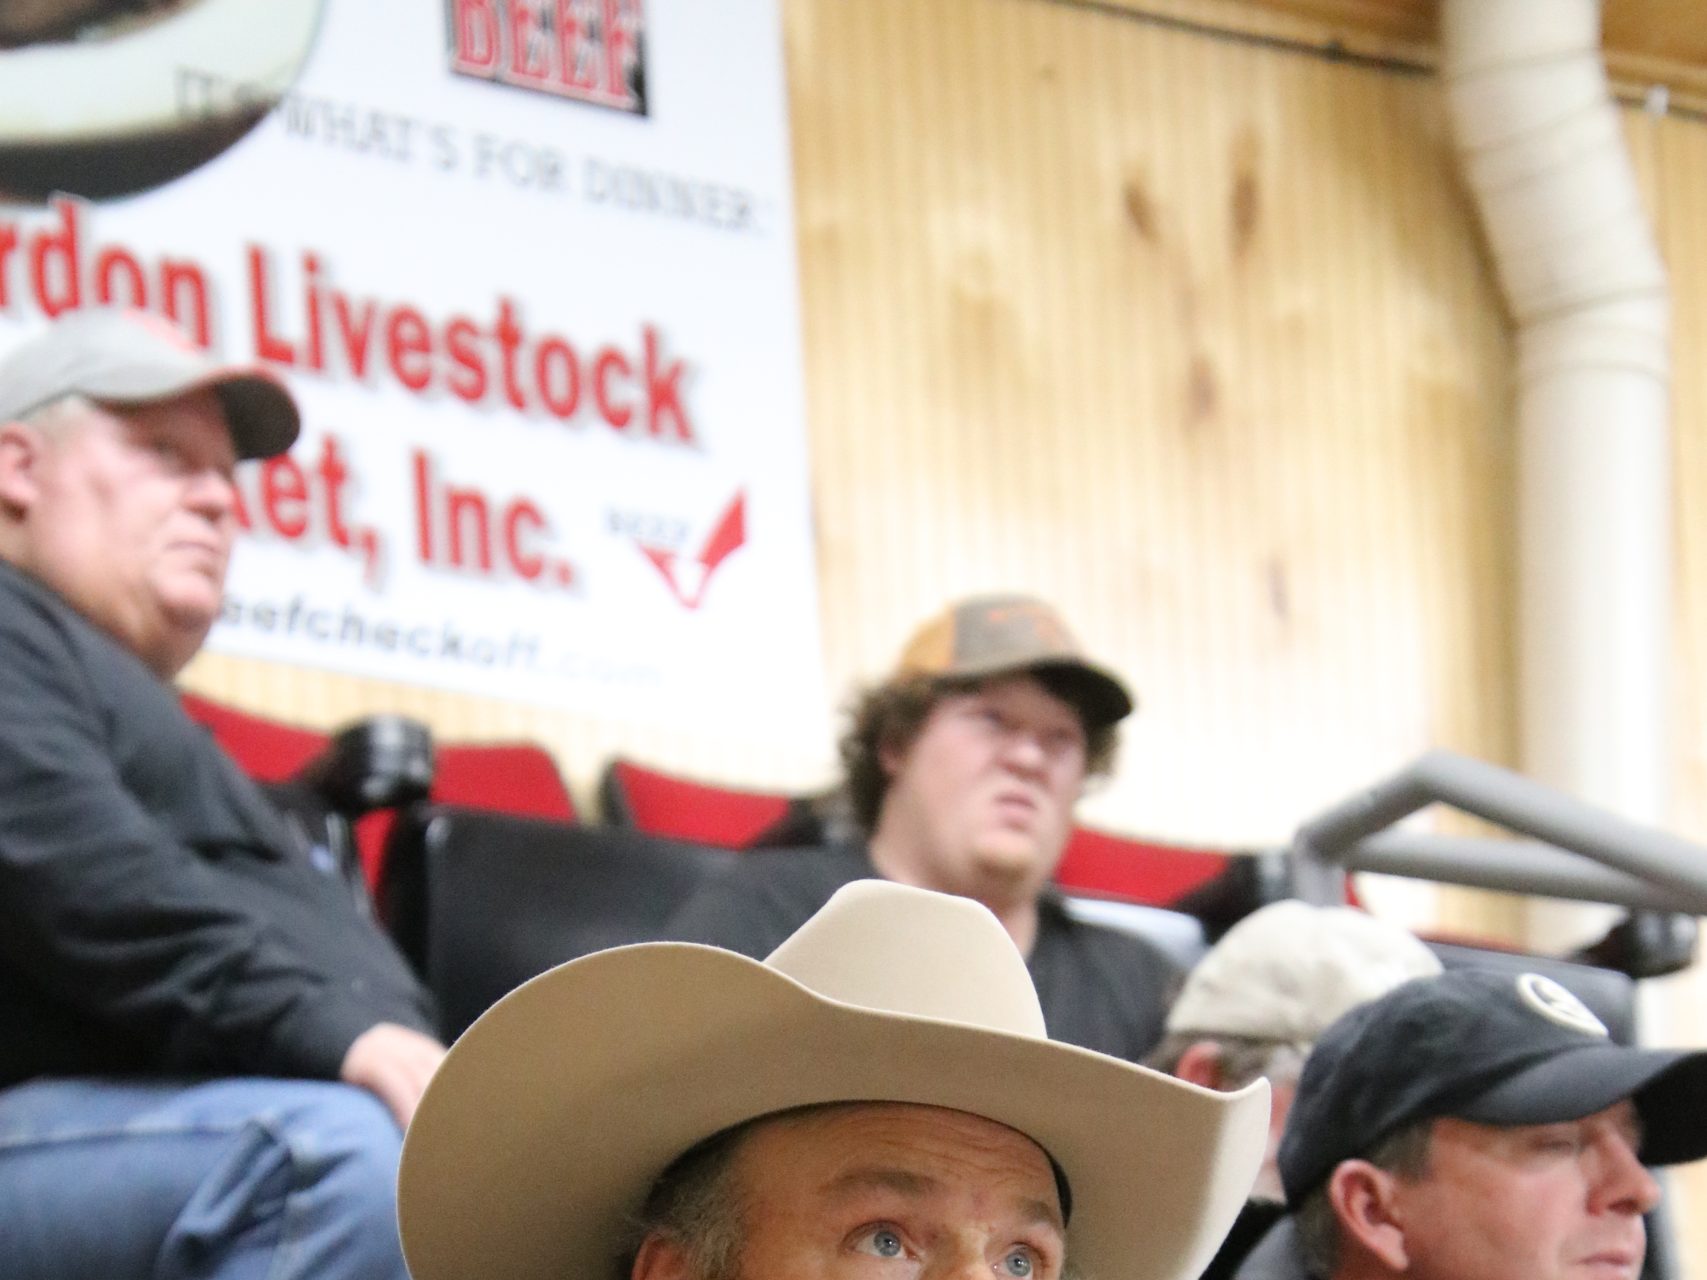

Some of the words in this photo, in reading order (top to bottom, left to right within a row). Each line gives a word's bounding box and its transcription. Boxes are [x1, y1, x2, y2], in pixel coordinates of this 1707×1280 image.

[475, 132, 565, 194] FOR
[246, 242, 696, 444] Livestock
[411, 448, 577, 588] Inc.
